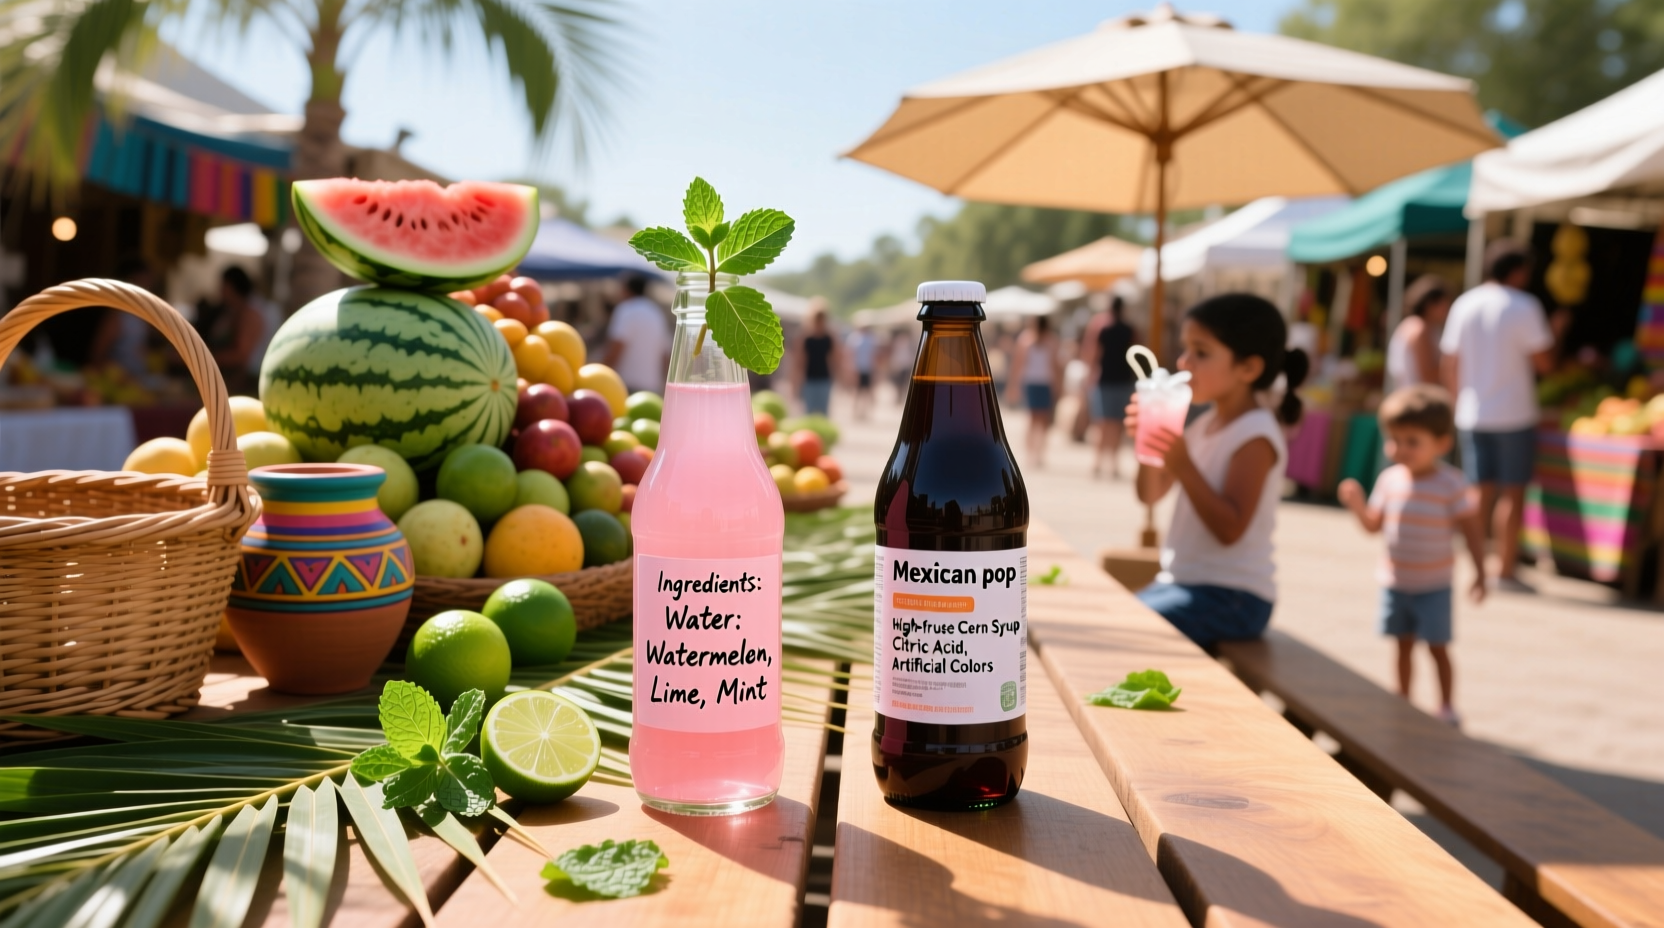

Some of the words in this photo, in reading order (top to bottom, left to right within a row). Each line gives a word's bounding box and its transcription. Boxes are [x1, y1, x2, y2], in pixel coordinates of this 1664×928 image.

[657, 570, 762, 601] Ingredients:
[893, 559, 976, 584] Mexican
[982, 566, 1017, 589] pop
[665, 604, 742, 630] Water:
[932, 640, 968, 656] Acid,
[892, 656, 946, 674] Artificial
[950, 659, 994, 673] Colors
[650, 675, 706, 709] Lime,
[716, 675, 768, 705] Mint
